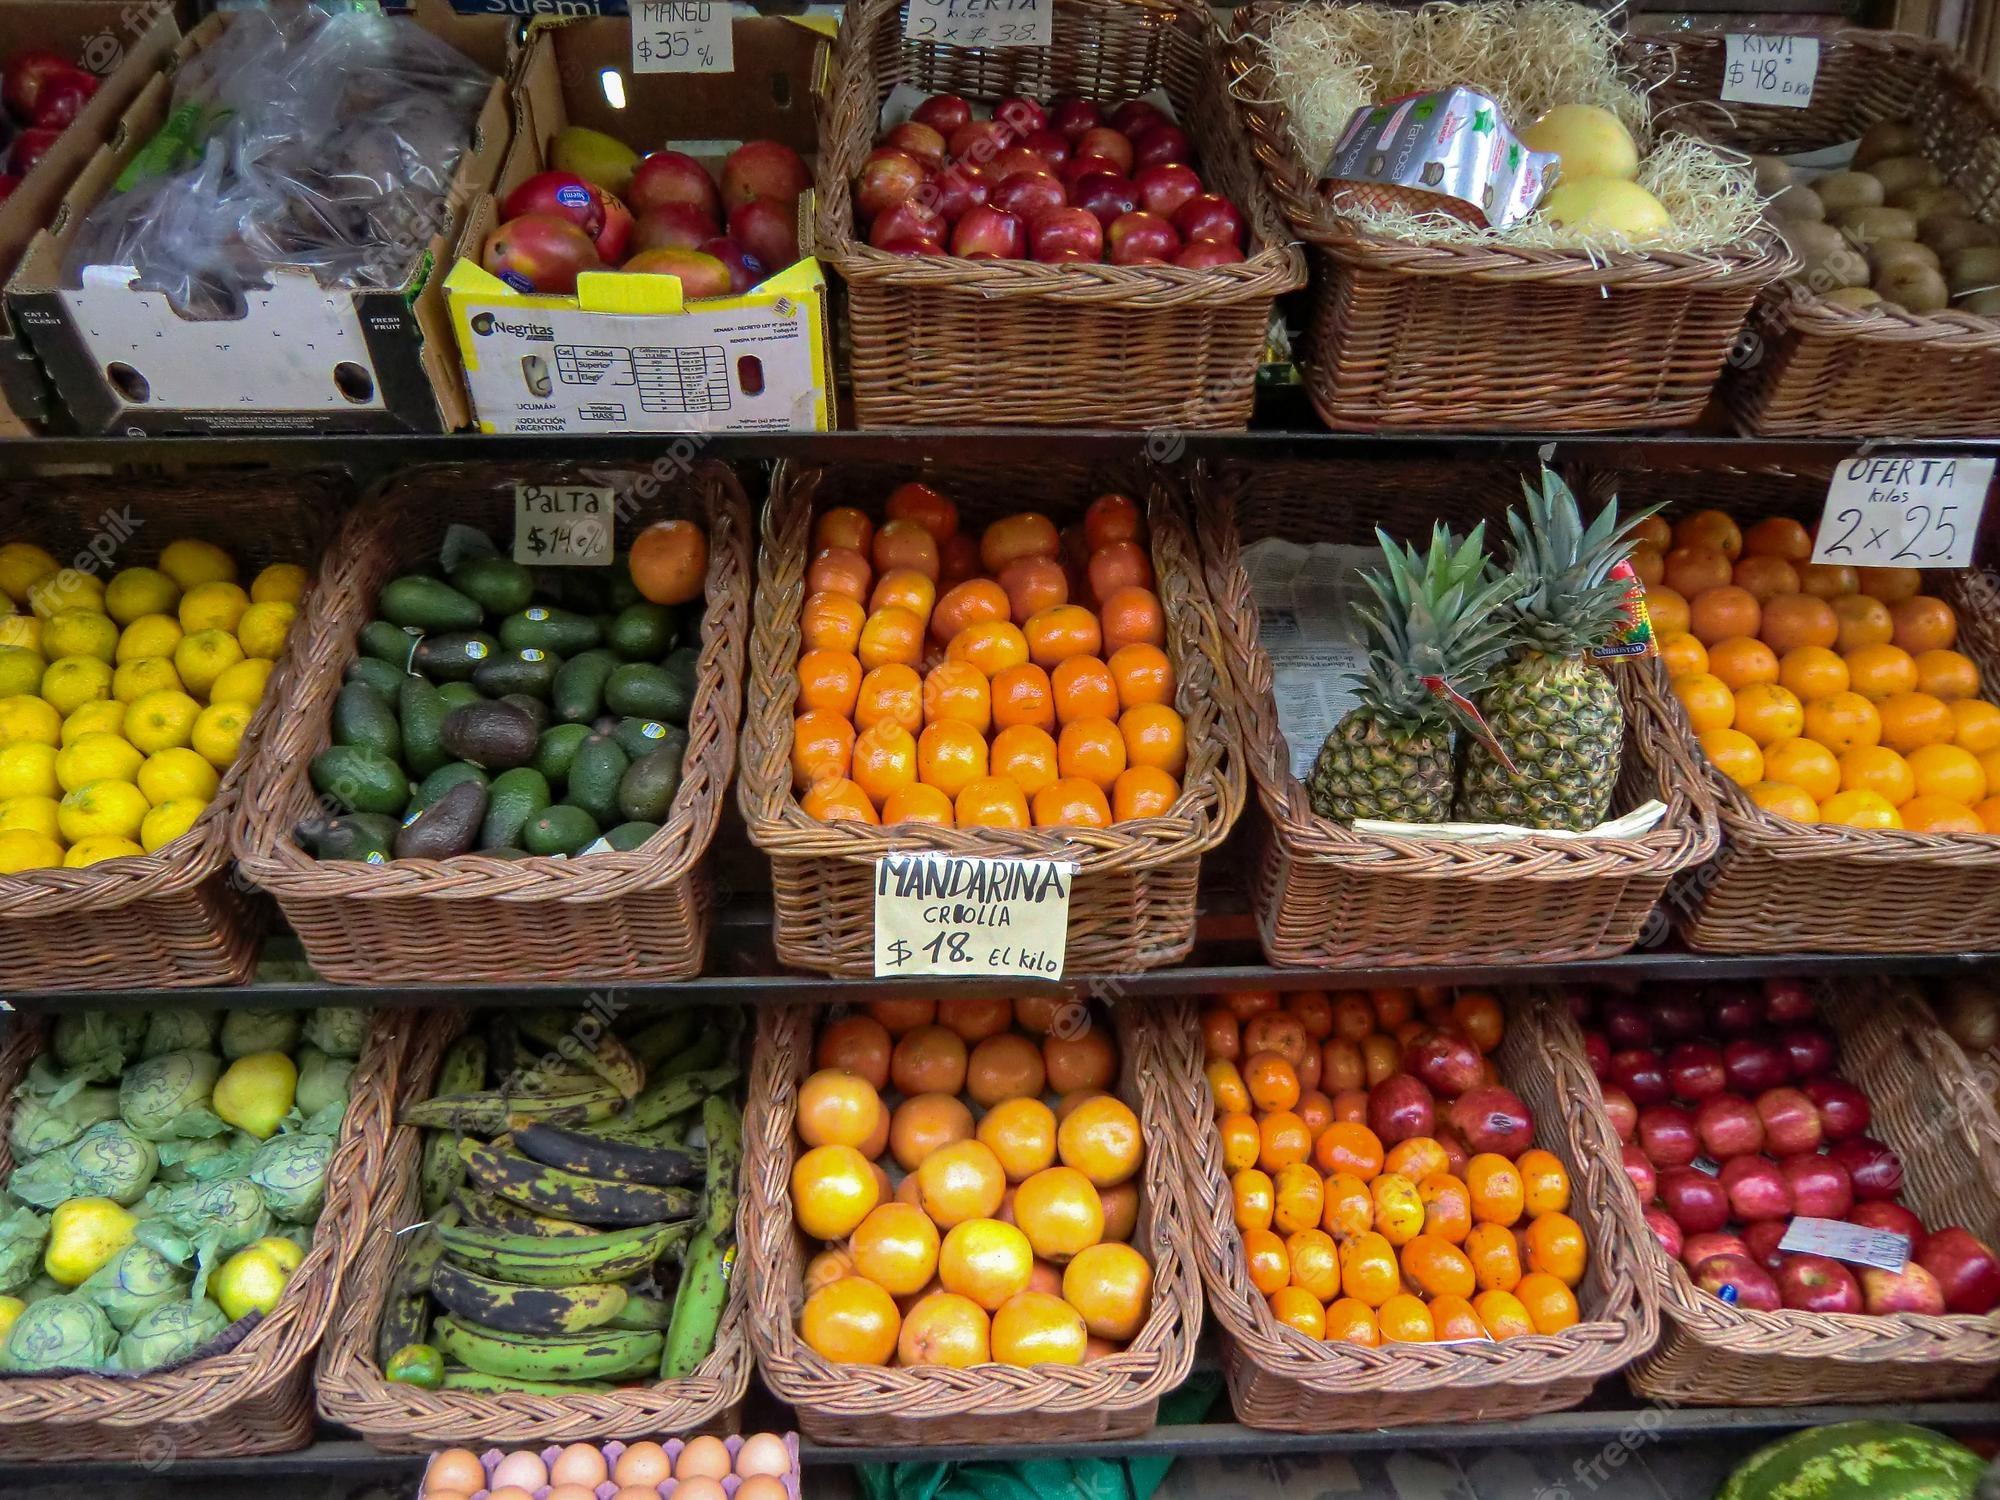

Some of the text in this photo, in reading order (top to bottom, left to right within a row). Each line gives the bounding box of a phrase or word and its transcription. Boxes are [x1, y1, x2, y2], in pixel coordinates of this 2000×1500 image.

[917, 17, 937, 38] 2
[1742, 35, 1793, 55] KIWI
[494, 321, 554, 338] Negritas
[578, 361, 611, 370] Superior
[515, 424, 564, 432] ARGENTINA
[1848, 459, 1957, 489] OFERTA
[1868, 487, 1910, 504] kilos
[1824, 508, 1863, 555] 2
[878, 857, 1066, 904] MANDARINA
